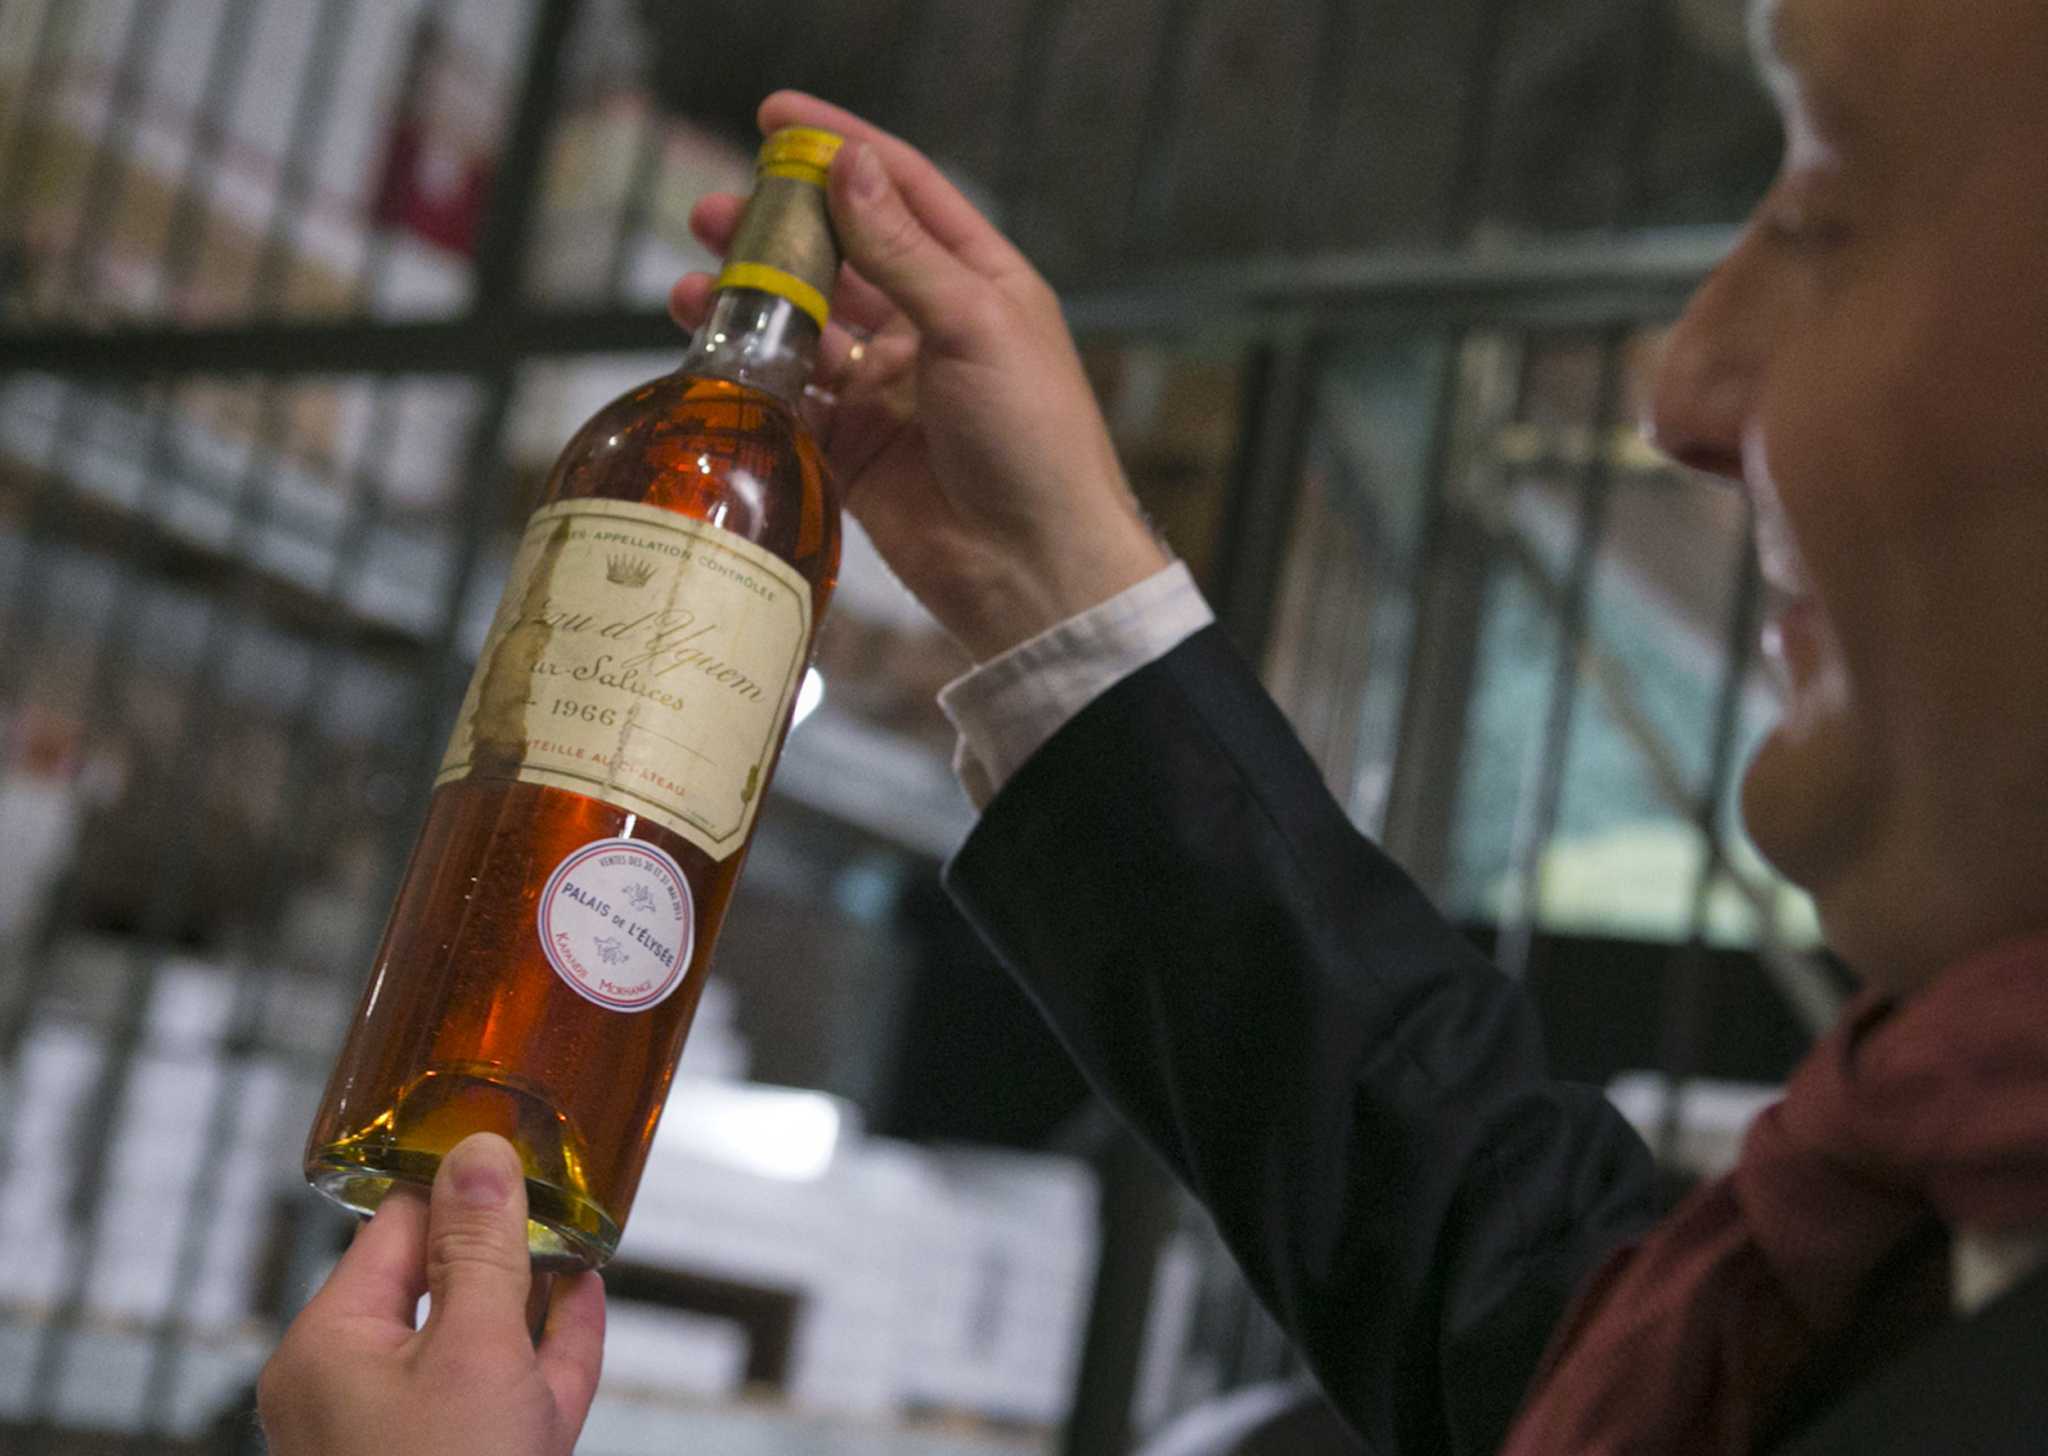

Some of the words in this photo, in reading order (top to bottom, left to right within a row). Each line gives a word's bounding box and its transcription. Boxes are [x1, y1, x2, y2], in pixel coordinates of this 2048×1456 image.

[593, 530, 692, 560] APPELLATION
[551, 699, 617, 727] 1966
[560, 881, 611, 918] PALAIS
[627, 921, 676, 968] L'ÉLYSÉE
